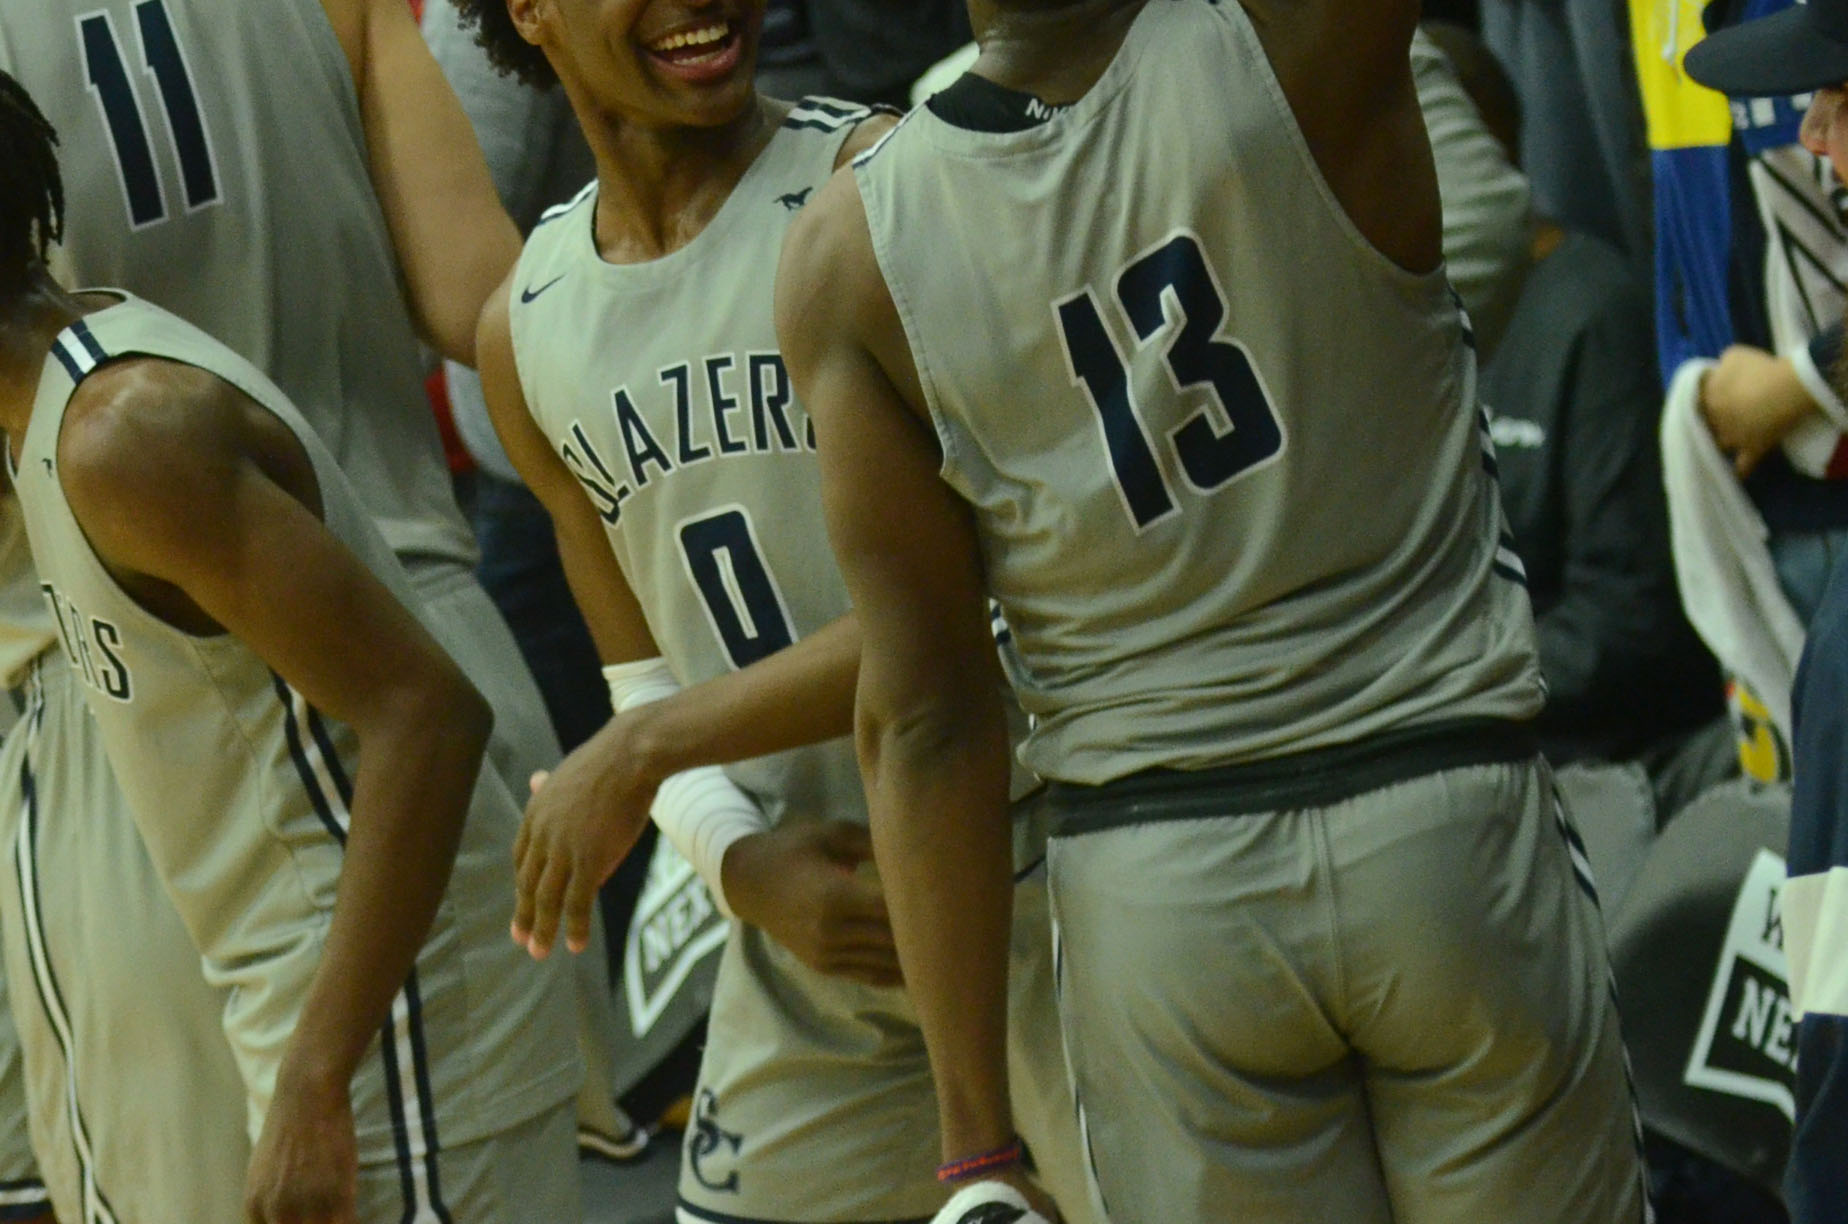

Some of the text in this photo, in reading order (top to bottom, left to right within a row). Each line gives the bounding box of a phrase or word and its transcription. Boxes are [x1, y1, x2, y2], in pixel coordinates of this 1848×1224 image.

[1051, 226, 1289, 536] 13
[675, 503, 800, 672] 0
[1732, 974, 1798, 1074] NE
